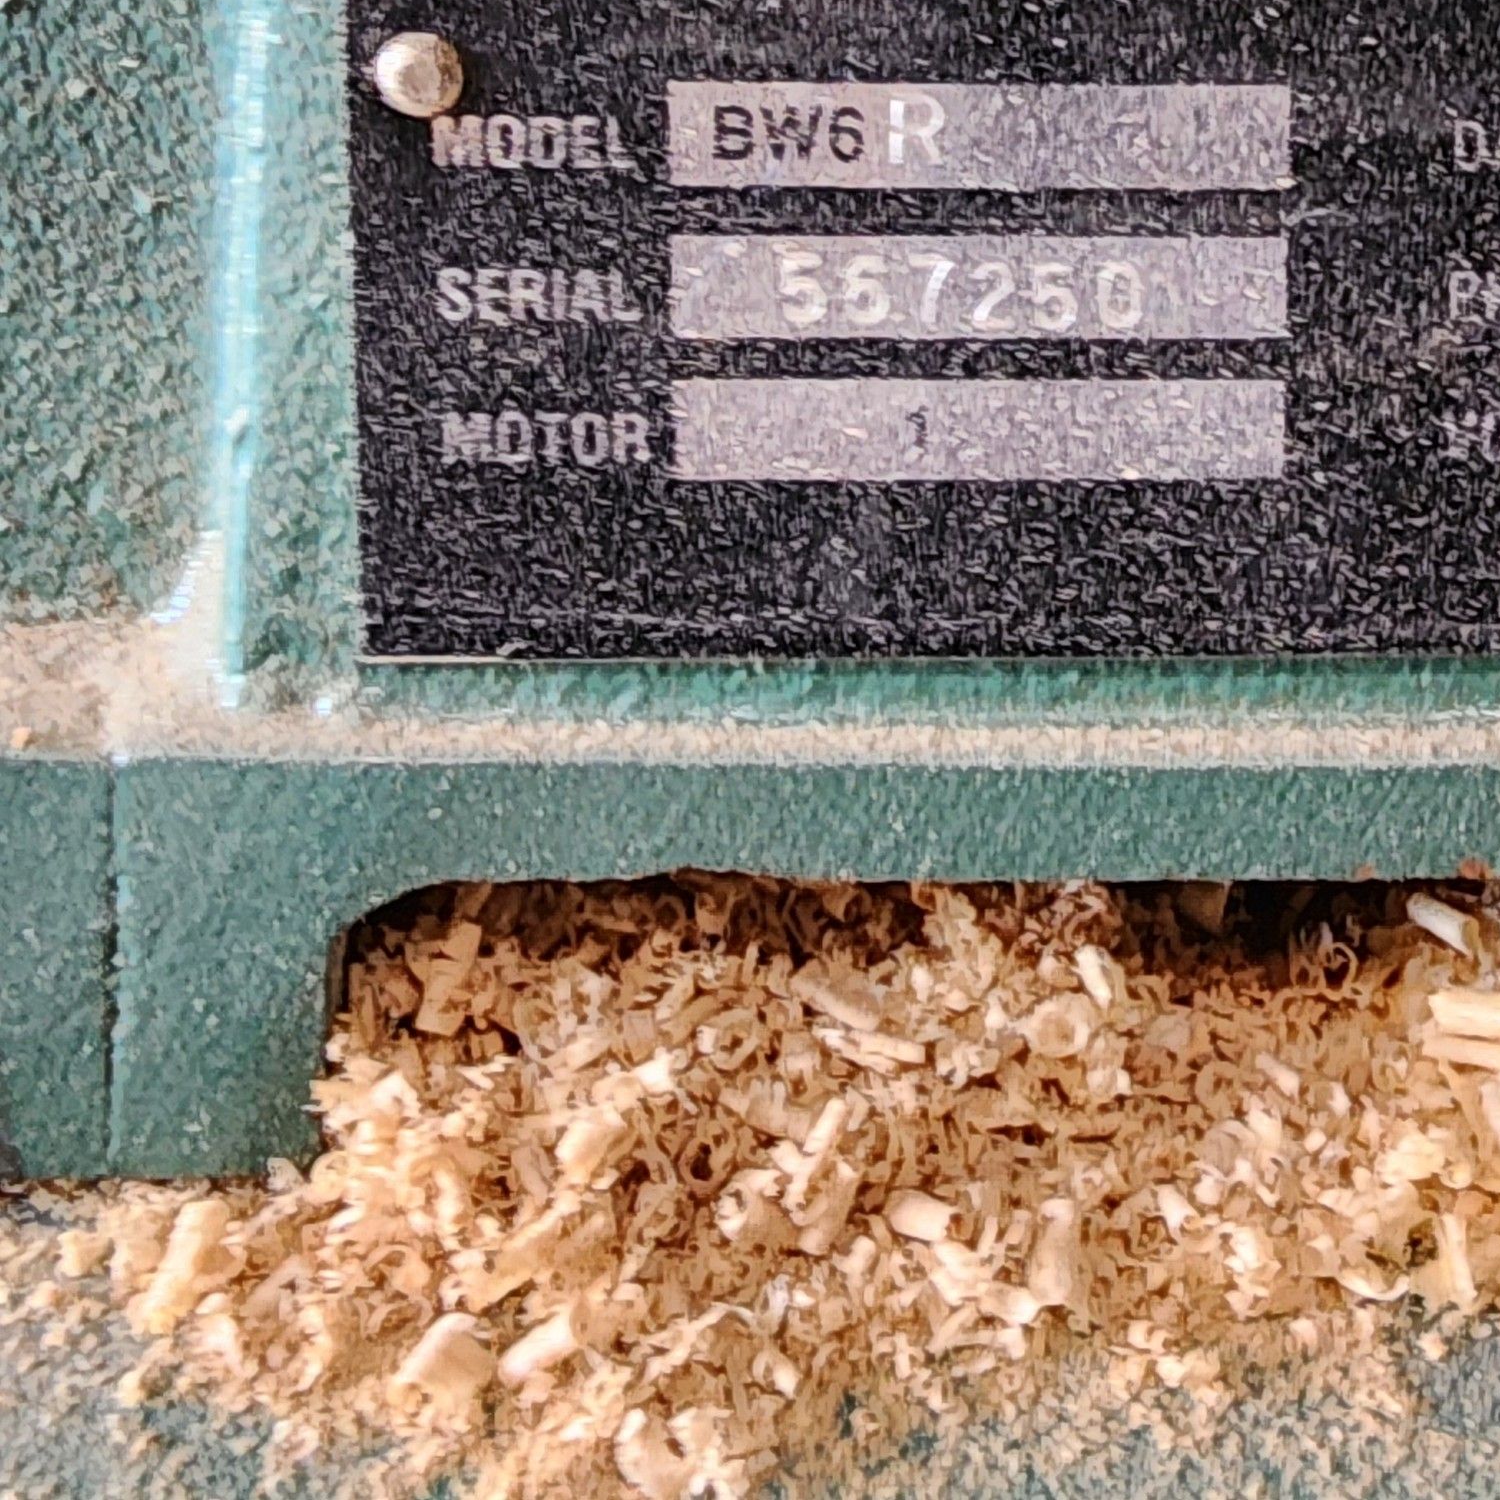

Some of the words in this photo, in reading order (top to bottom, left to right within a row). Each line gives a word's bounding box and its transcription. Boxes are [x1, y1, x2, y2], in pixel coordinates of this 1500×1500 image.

[430, 113, 634, 169] MODEL
[435, 264, 642, 323] SERIAL
[440, 408, 653, 468] MOTOR
